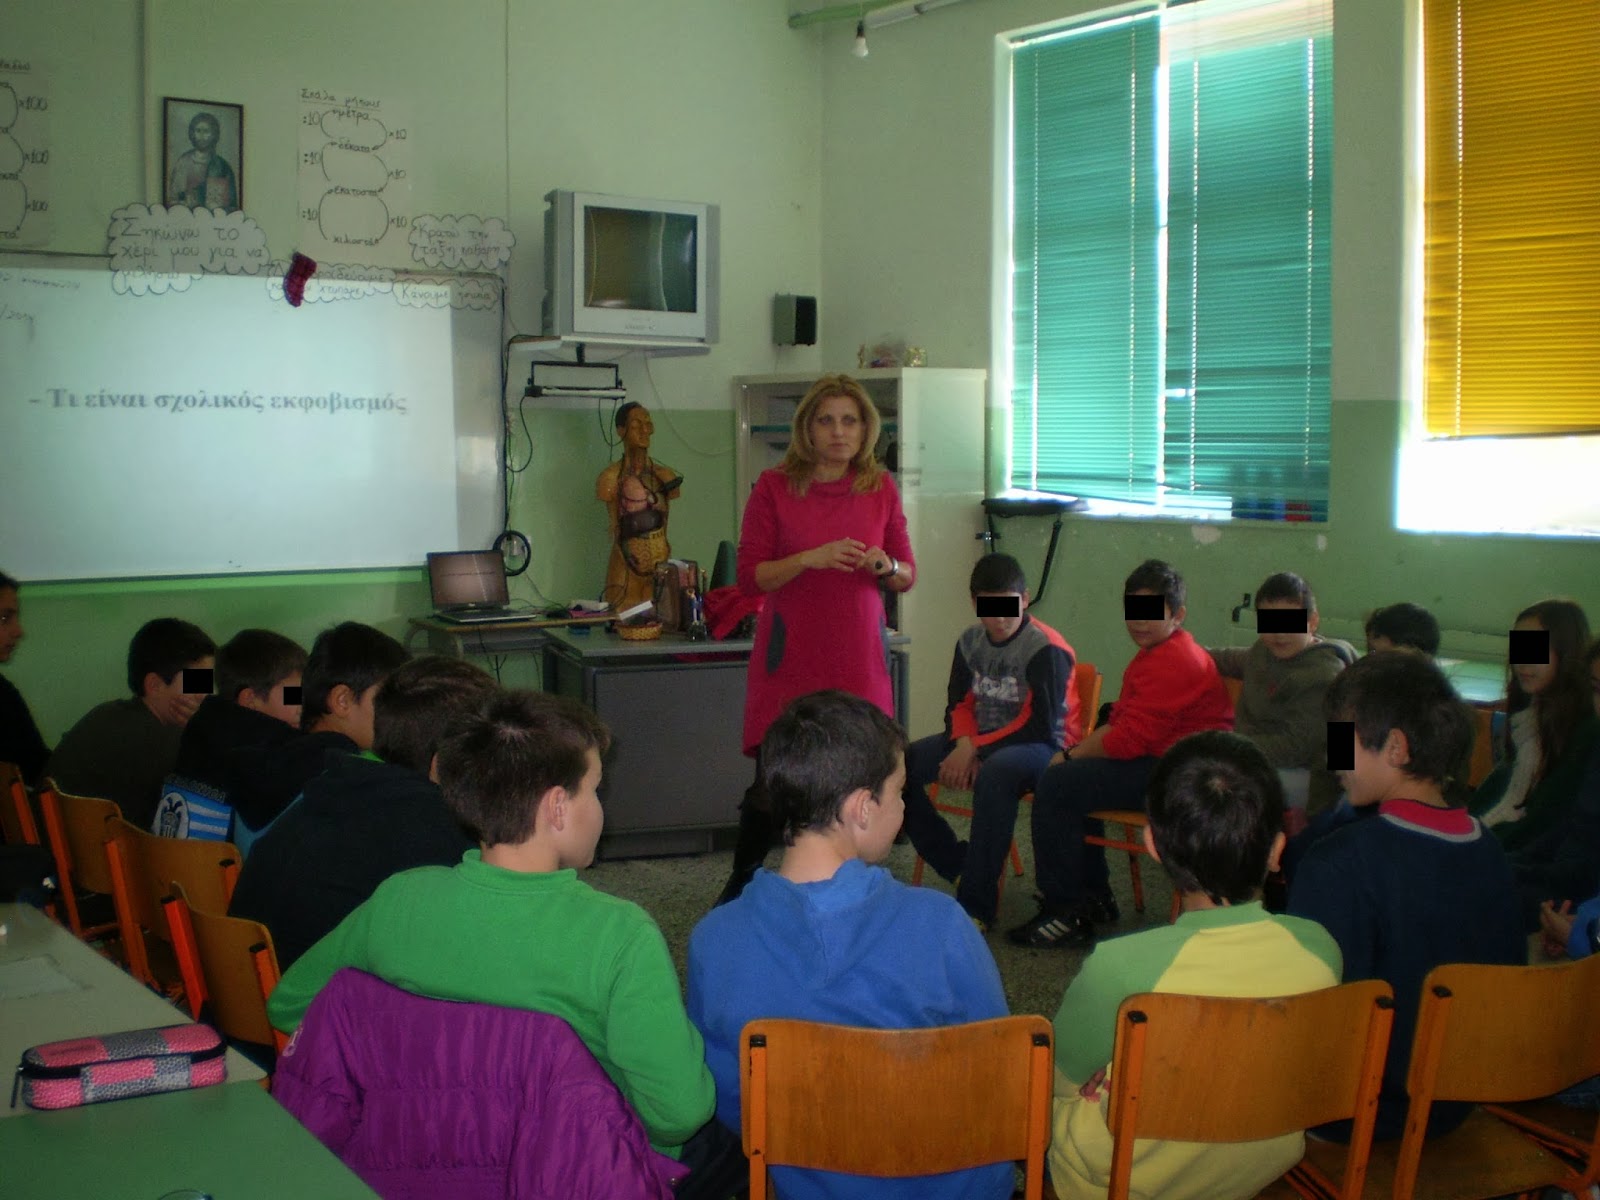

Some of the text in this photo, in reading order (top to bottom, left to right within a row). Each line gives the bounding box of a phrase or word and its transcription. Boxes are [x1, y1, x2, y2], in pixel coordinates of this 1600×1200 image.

[121, 217, 239, 241] Σηκώνω το
[121, 244, 263, 270] χέρι μου για να
[48, 388, 79, 408] Τι
[84, 390, 147, 409] είναι
[154, 389, 264, 414] σχολικός
[270, 390, 408, 415] εκφοβισμός
